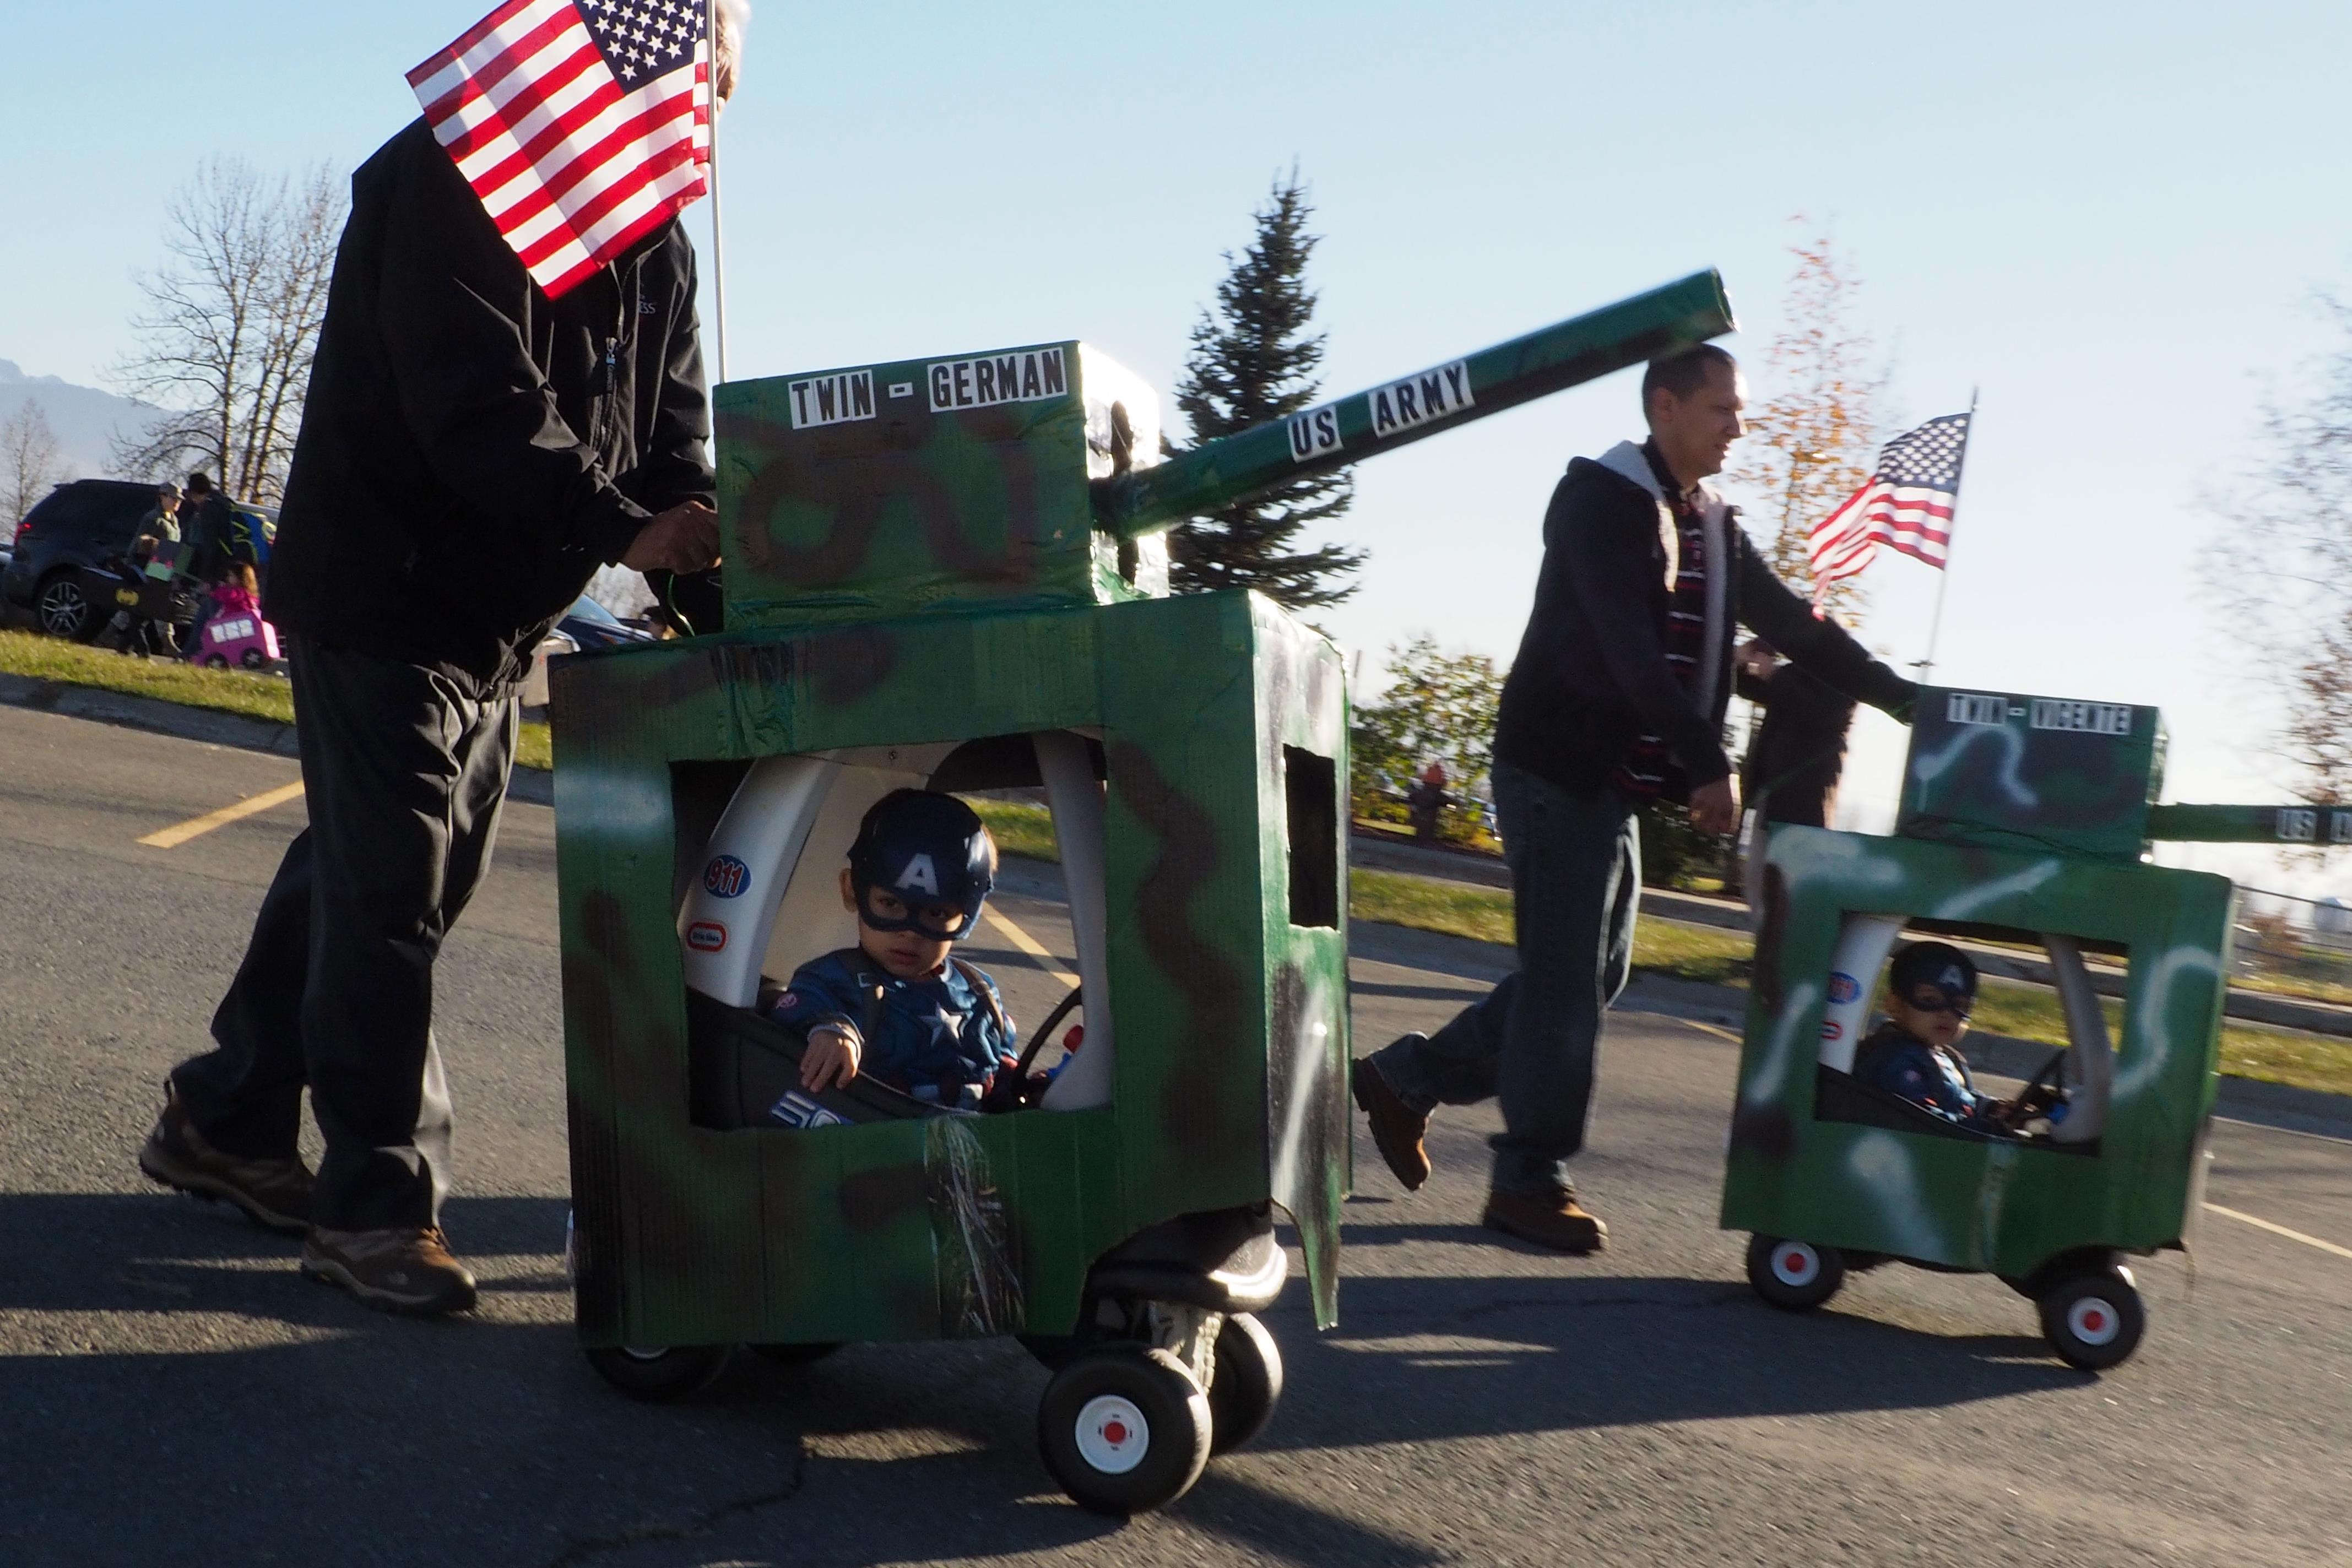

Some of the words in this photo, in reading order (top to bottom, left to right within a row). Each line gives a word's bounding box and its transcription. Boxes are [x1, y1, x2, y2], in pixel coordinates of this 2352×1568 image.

[792, 372, 872, 425] TWIN
[931, 350, 1065, 408] GERMAN
[1292, 409, 1336, 456] US
[1376, 365, 1464, 432] ARMY
[707, 858, 744, 896] 911
[895, 853, 940, 896] A
